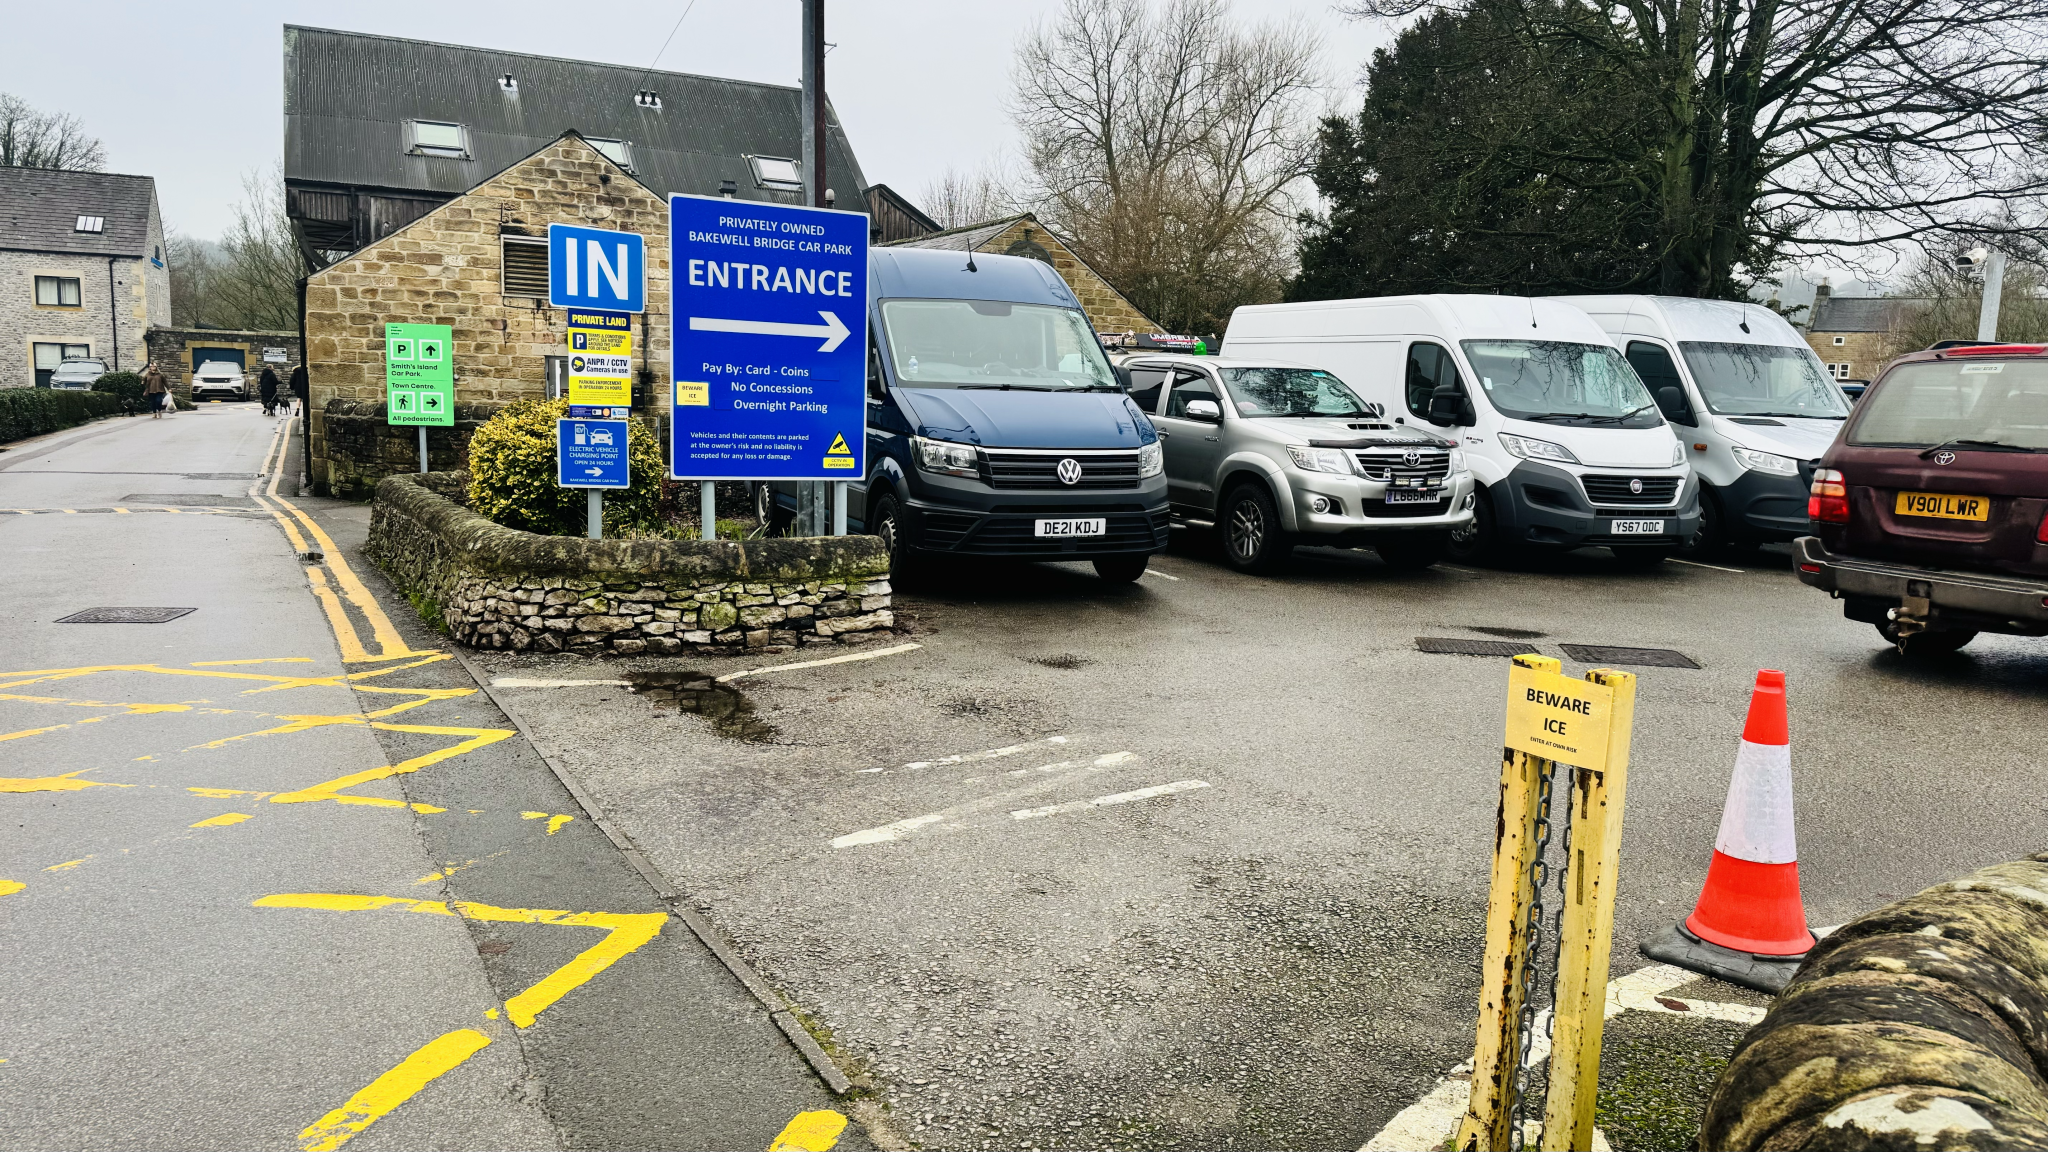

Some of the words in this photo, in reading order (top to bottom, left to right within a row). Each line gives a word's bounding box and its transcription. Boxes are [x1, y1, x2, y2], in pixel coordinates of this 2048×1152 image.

[719, 216, 778, 231] PRIVATELY
[781, 222, 825, 236] OWNED
[689, 230, 750, 246] BAKEWELL
[754, 237, 796, 250] BRIDGE
[798, 241, 821, 252] CAR
[824, 244, 852, 255] PARK
[566, 237, 628, 300] IN
[688, 258, 852, 297] ENTRANCE
[572, 314, 604, 326] PRIVATE
[606, 316, 627, 327] LAND
[576, 334, 584, 348] P
[398, 344, 406, 354] P
[702, 362, 722, 375] Pay
[726, 364, 742, 376] By:
[746, 364, 770, 375] Card
[781, 366, 809, 377] Coins
[731, 382, 746, 392] No
[750, 383, 813, 394] Concessions
[734, 400, 787, 412] Overnight
[790, 402, 828, 414] Parking
[1907, 496, 1942, 513] V901
[1945, 498, 1979, 516] LWR
[1044, 522, 1072, 534] DE21
[1075, 521, 1099, 534] KDJ
[1616, 522, 1640, 532] YS67
[1642, 522, 1660, 532] ODC
[1526, 688, 1591, 715] BEWARE
[1544, 718, 1567, 735] ICE
[1530, 736, 1544, 745] ENTER
